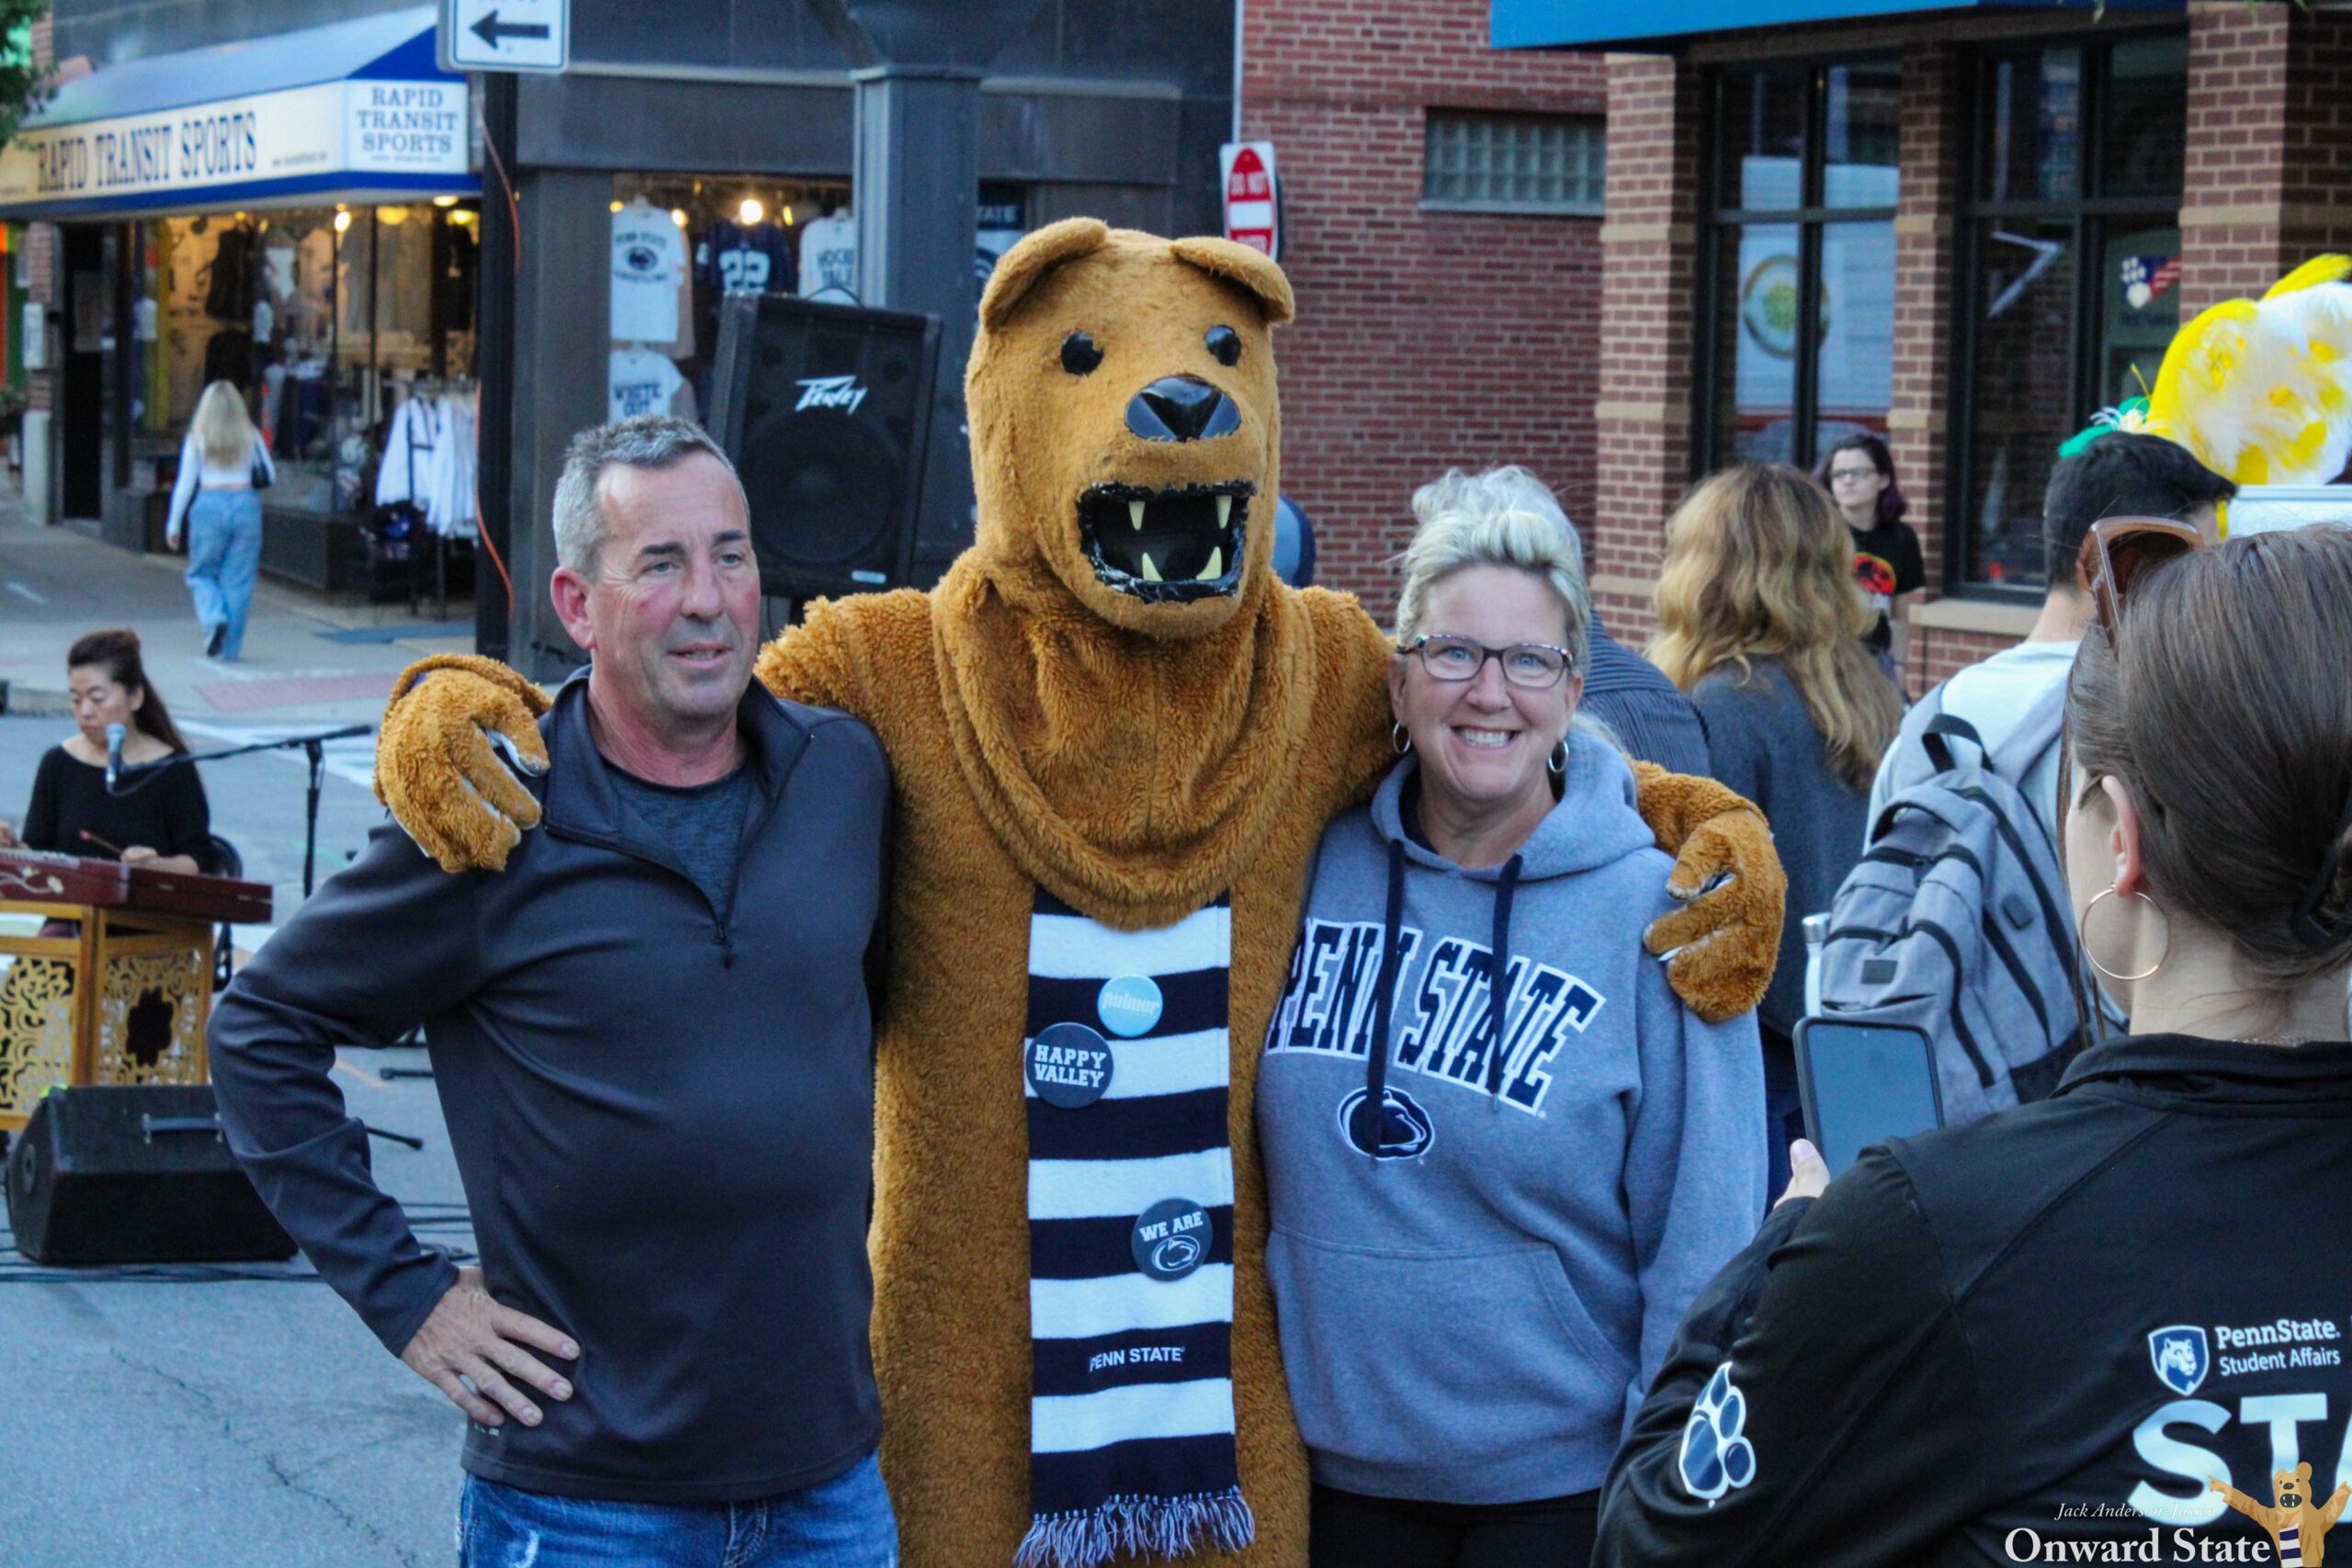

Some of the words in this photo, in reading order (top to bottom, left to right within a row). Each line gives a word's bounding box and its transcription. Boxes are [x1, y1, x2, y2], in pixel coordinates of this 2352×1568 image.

[371, 86, 443, 107] RAPID
[356, 109, 458, 131] TRANSIT
[38, 137, 88, 192] RAPID
[96, 125, 172, 188] TRANSIT
[181, 111, 256, 177] SPORTS
[362, 133, 453, 154] SPORTS
[1231, 171, 1246, 195] DO
[1247, 169, 1267, 195] NOT
[1265, 918, 1423, 1061] PENN
[1393, 936, 1607, 1117] STATE
[1035, 1043, 1107, 1069] HAPPY
[1034, 1063, 1104, 1089] VALLEY
[1139, 1222, 1169, 1242] WE
[1172, 1212, 1204, 1234] ARE
[1089, 1349, 1125, 1372] PENN
[1129, 1347, 1182, 1362] STATE
[2219, 1351, 2287, 1377] Student
[2290, 1346, 2341, 1369] Affairs
